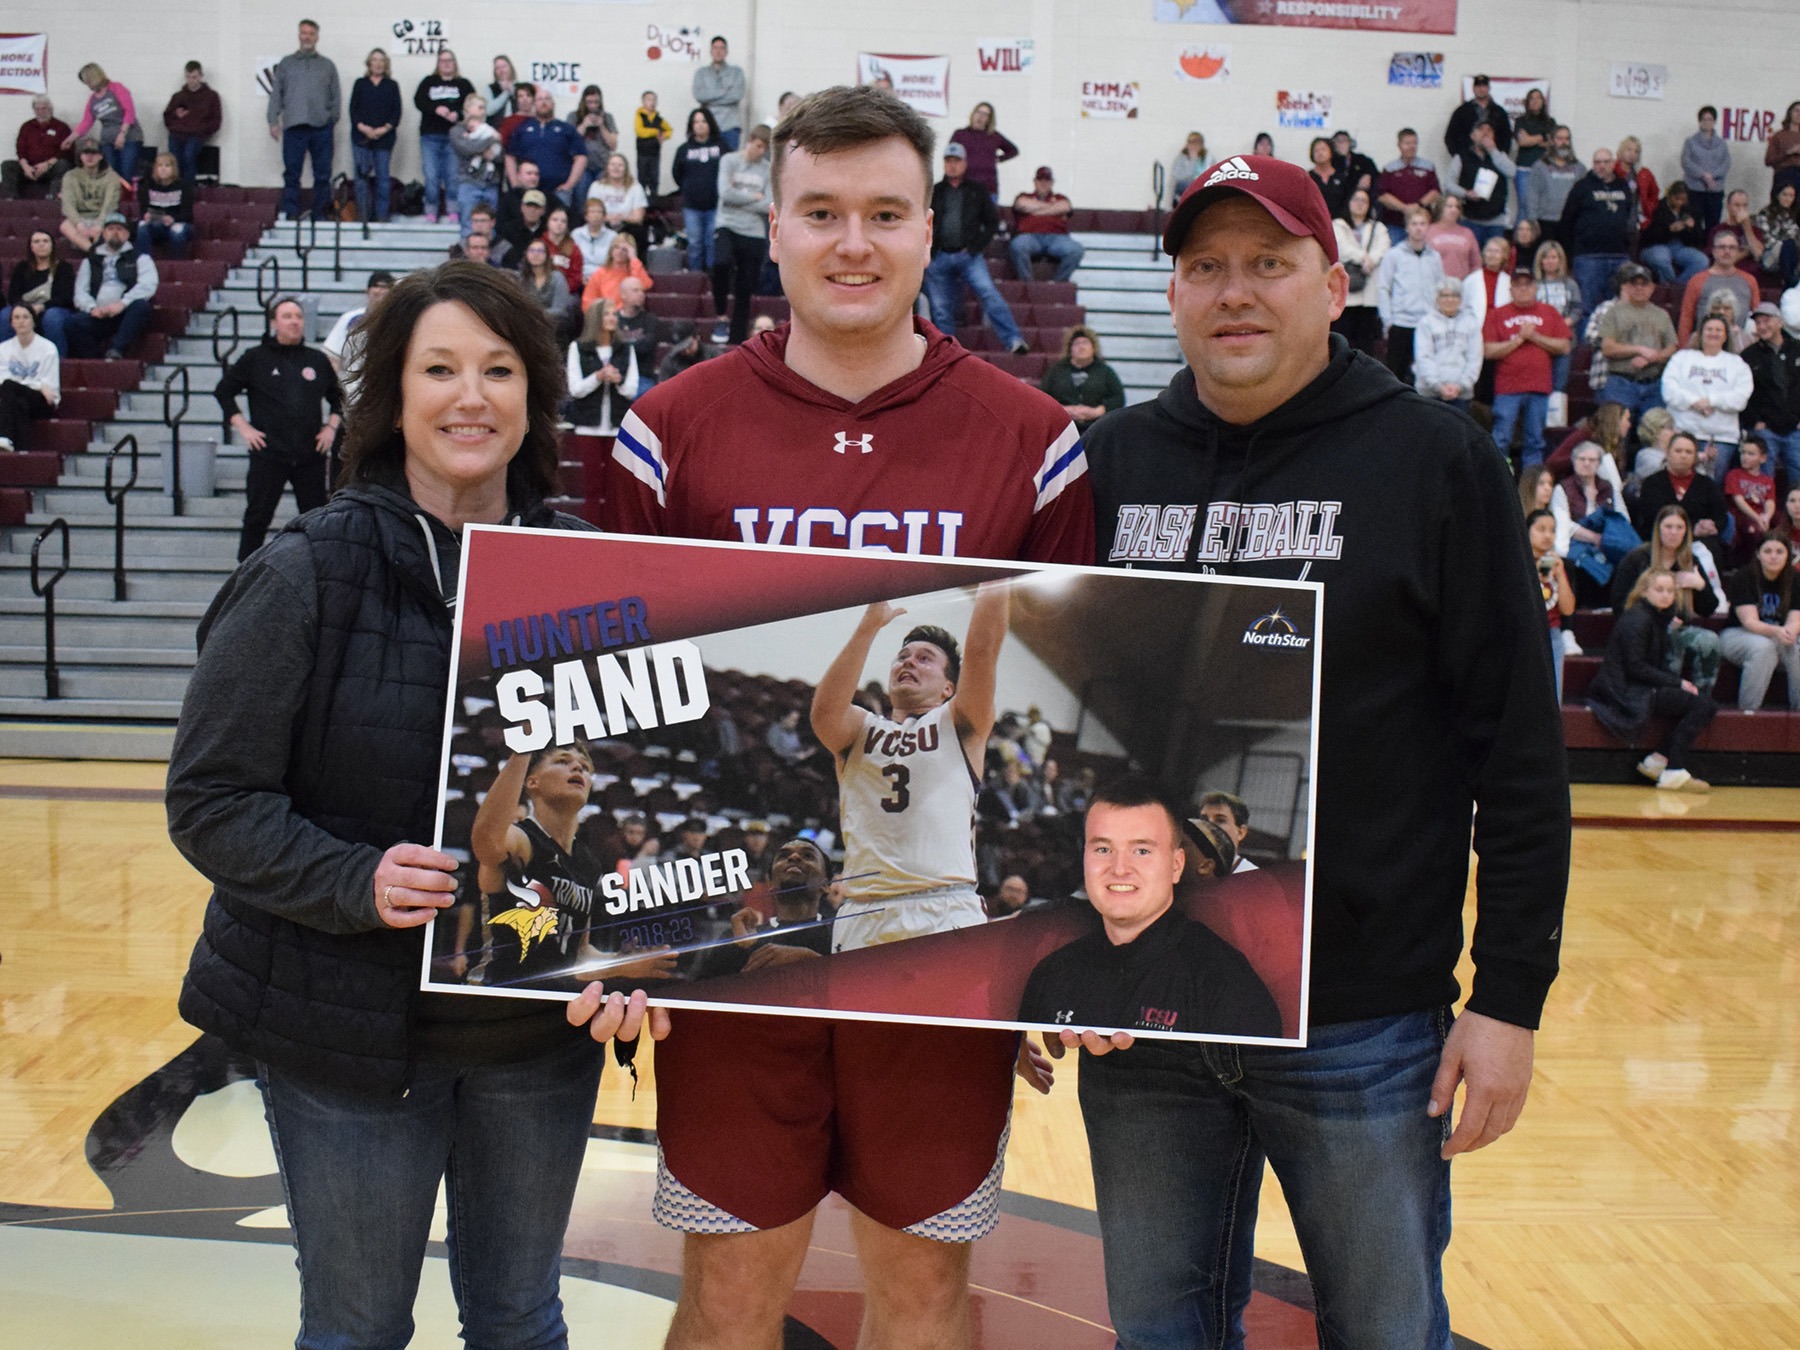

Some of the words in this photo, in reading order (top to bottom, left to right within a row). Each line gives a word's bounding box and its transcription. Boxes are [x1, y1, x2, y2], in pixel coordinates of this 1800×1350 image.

[1276, 1, 1402, 20] RESPONSIBILITY
[0, 53, 34, 62] HOME
[532, 62, 580, 81] EDDIE
[1082, 82, 1132, 98] EMMA
[1203, 168, 1260, 187] adidas
[1108, 500, 1344, 563] BASKETBALL
[485, 596, 650, 669] HUNTER
[1242, 631, 1310, 647] NorthStar
[495, 639, 711, 754] SAND
[864, 723, 939, 757] VCSU
[881, 763, 910, 813] 3
[601, 848, 752, 916] SANDER
[620, 917, 694, 950] 2018-23
